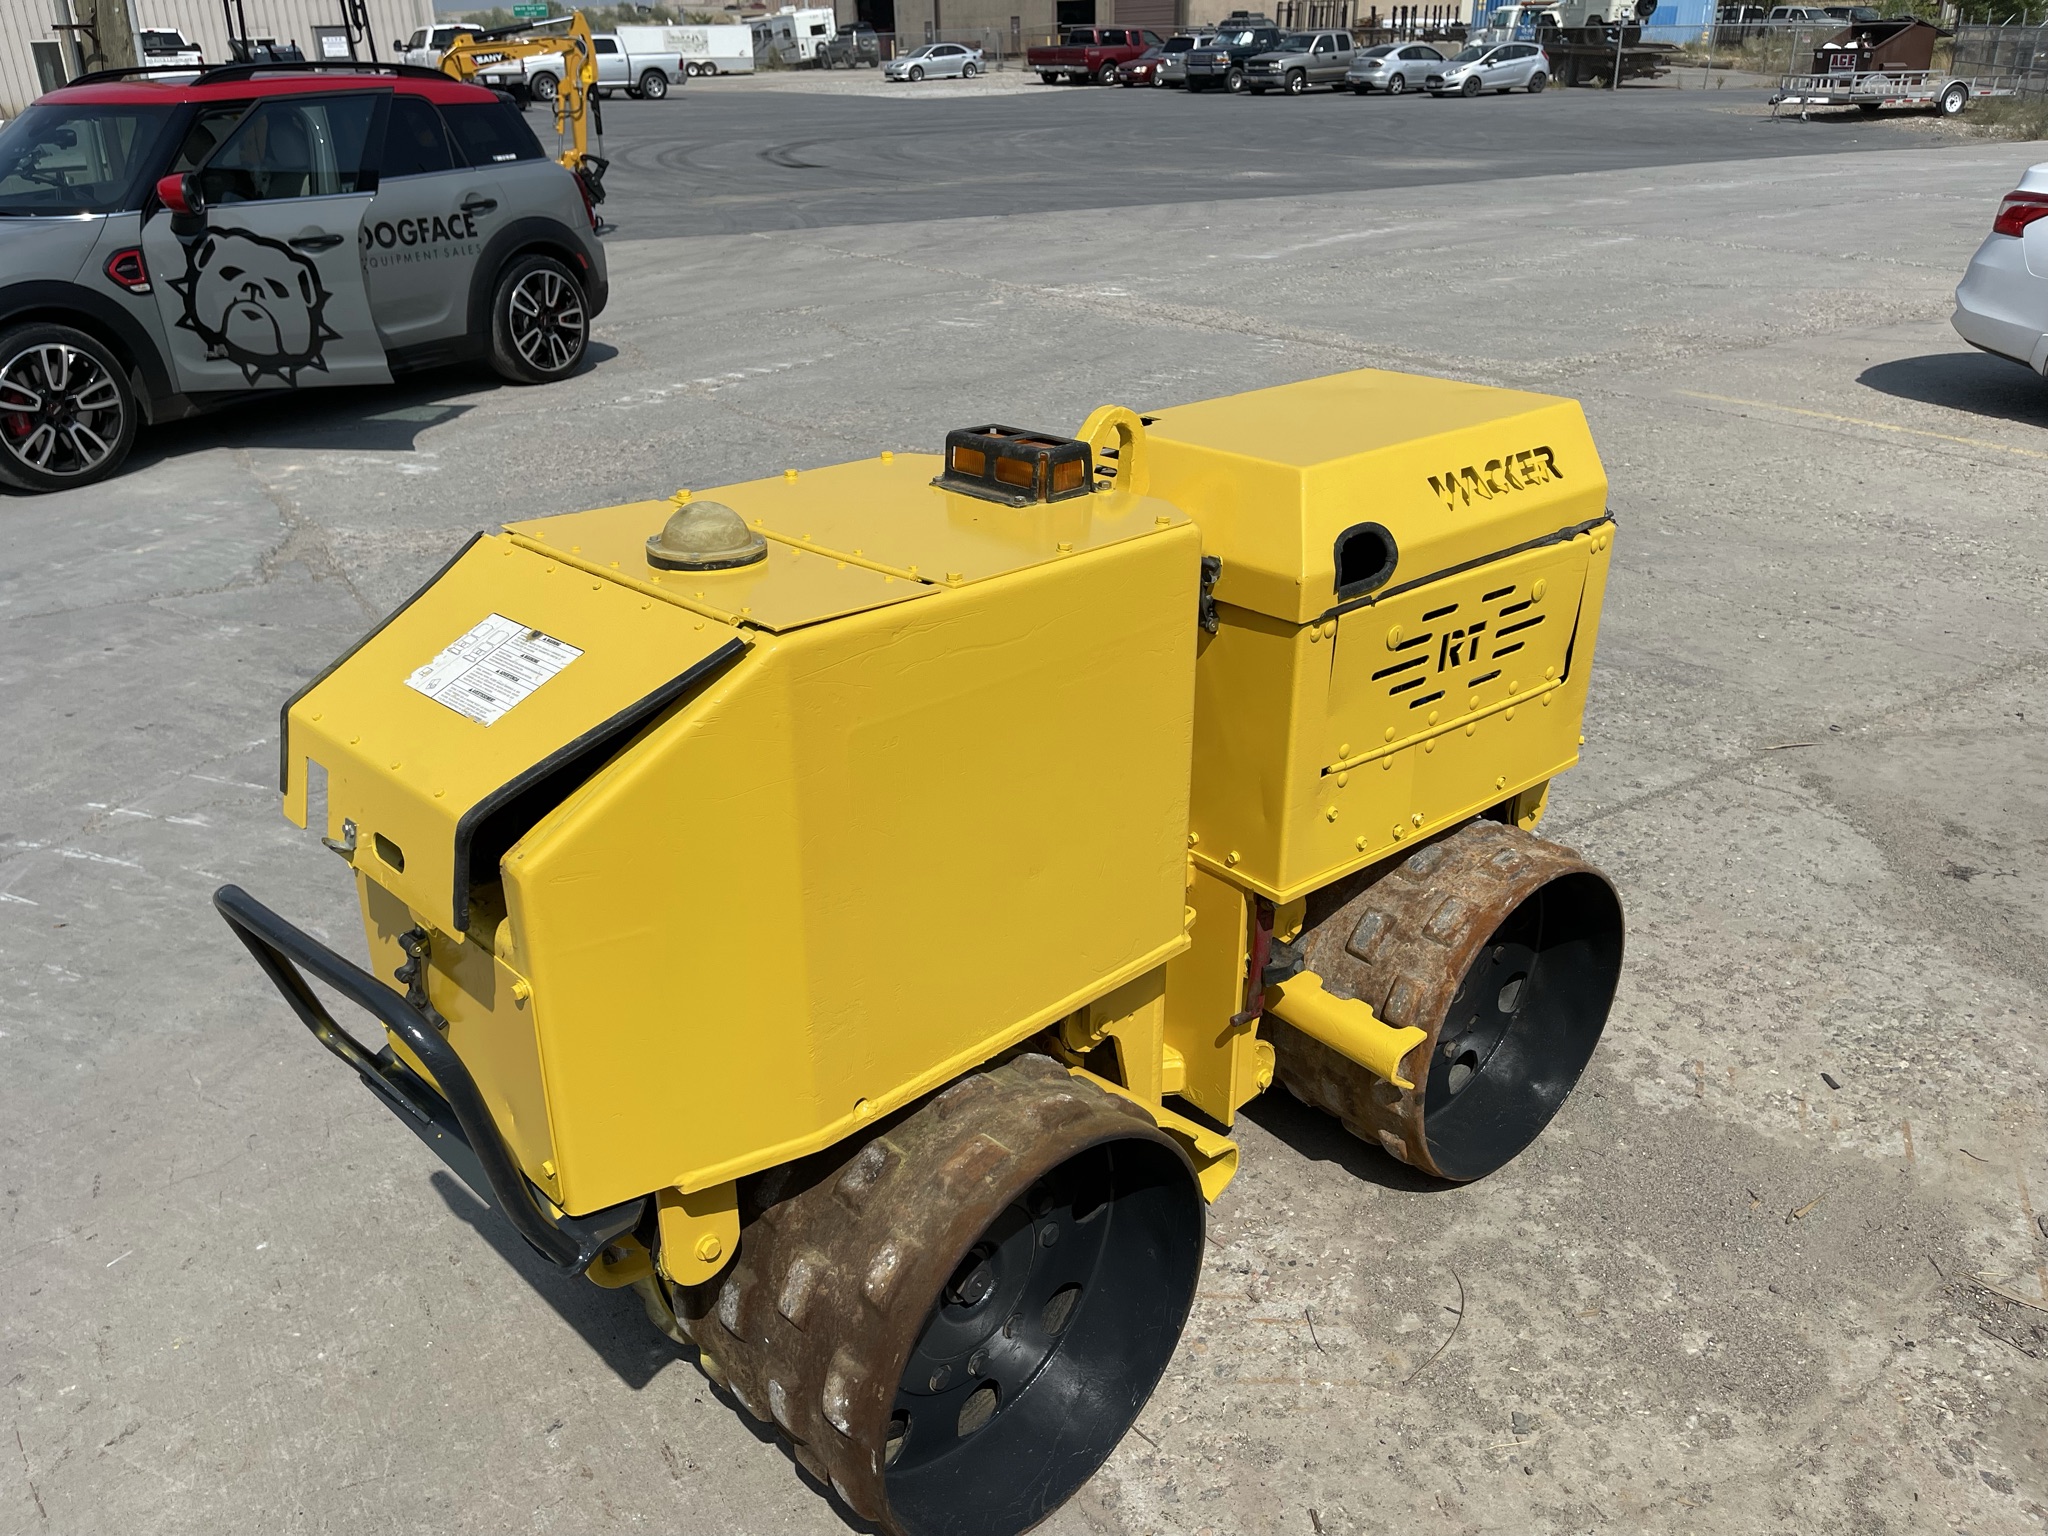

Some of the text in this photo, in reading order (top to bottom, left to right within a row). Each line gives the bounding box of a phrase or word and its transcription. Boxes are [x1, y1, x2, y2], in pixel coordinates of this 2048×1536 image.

[1831, 55, 1856, 66] ACE
[367, 243, 482, 269] QUIPMENT SALES
[1427, 445, 1563, 512] WACKER
[1437, 620, 1488, 674] RT
